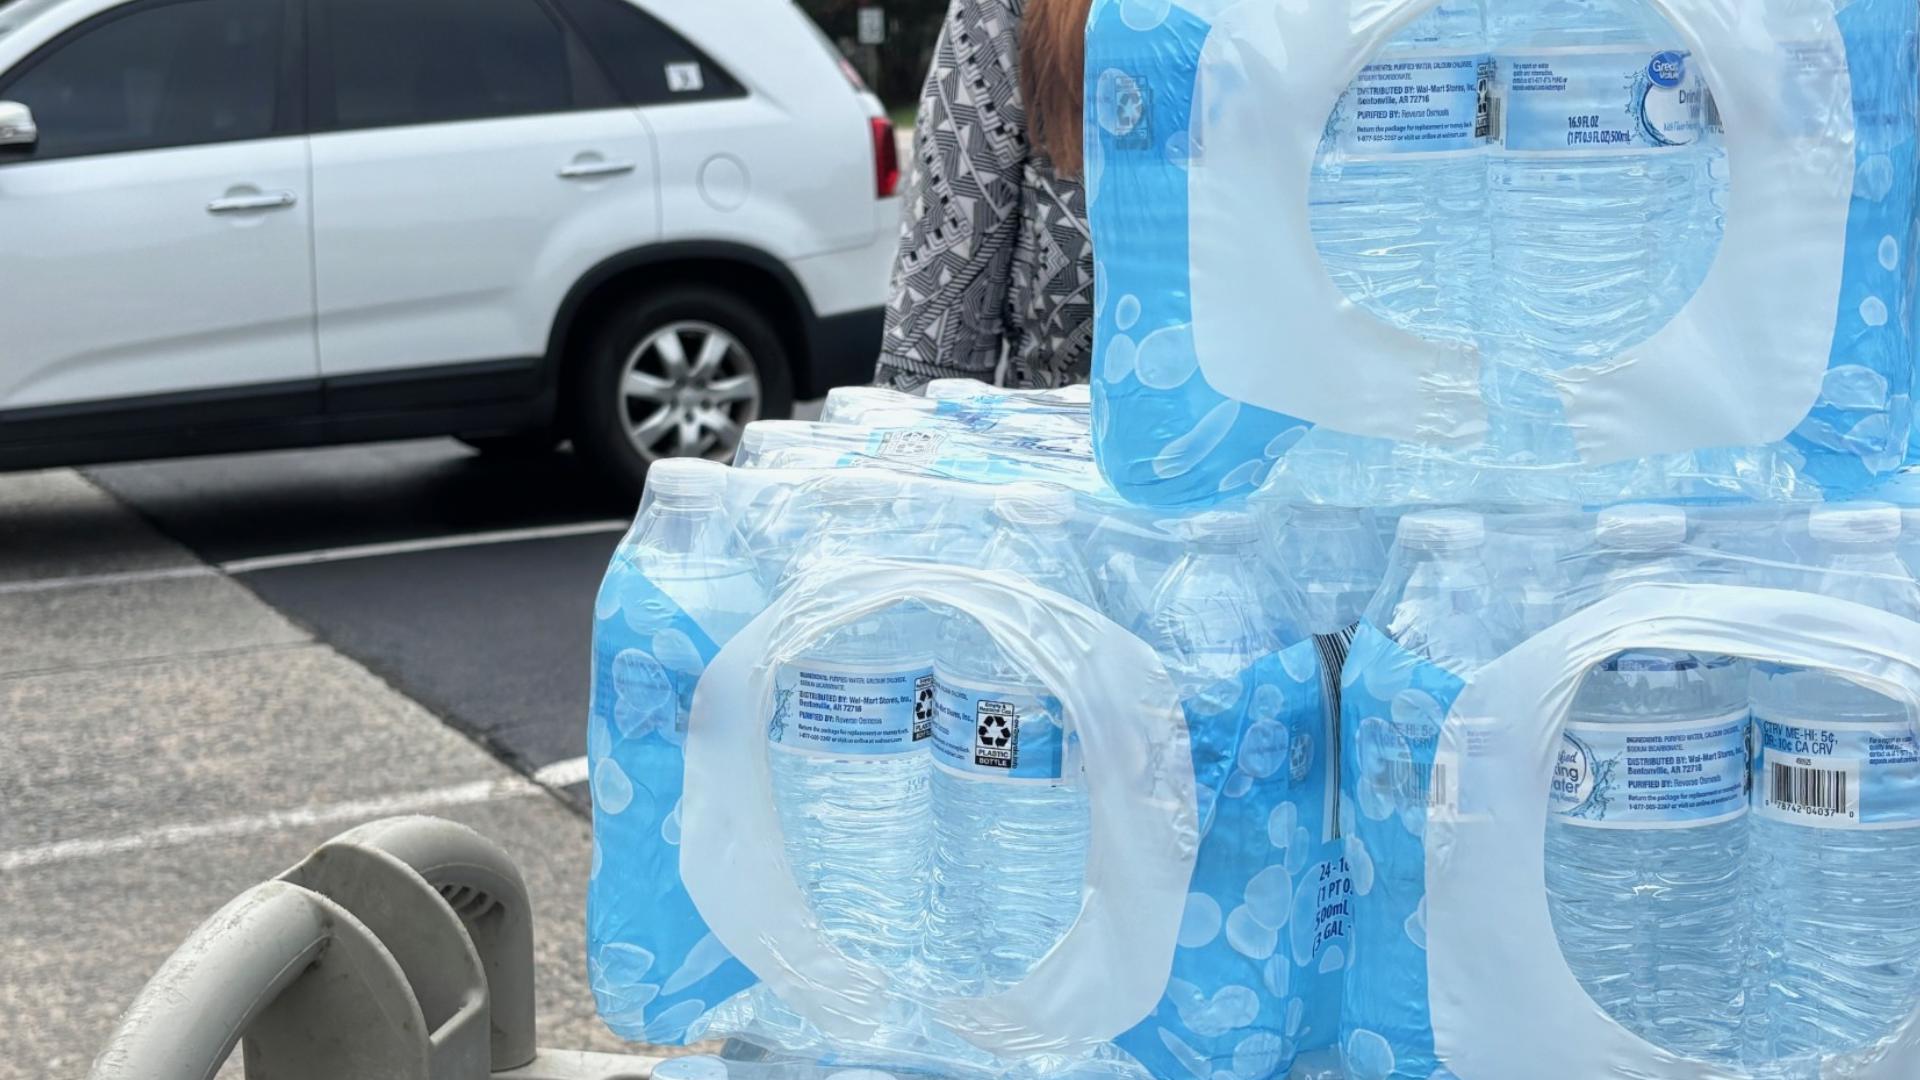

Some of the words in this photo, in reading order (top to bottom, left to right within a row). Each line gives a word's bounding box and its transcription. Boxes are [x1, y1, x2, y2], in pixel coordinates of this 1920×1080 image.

[1357, 86, 1403, 96] DISTRIBUTED
[1404, 85, 1415, 95] BY:
[1416, 84, 1445, 94] Wal-Mart
[1398, 95, 1409, 104] AR
[1357, 110, 1388, 119] PURIFIED
[1389, 110, 1401, 118] BY:
[1401, 109, 1425, 118] Reverse
[1568, 115, 1582, 128] 16.9
[1582, 115, 1590, 128] FL
[1590, 115, 1600, 128] OZ
[1567, 131, 1573, 146] (1
[1574, 131, 1582, 144] PT
[1583, 131, 1592, 143] 0.9
[1593, 130, 1600, 143] FL
[838, 694, 849, 703] BY:
[849, 696, 878, 705] Wal-Mart
[1785, 726, 1818, 742] ME-HI:
[1821, 729, 1838, 745] 5¢,
[978, 749, 1009, 758] PLASTIC
[1795, 740, 1809, 753] CA
[1812, 742, 1833, 755] CRV
[979, 757, 1008, 767] BOTTLE
[1627, 757, 1674, 766] DISTRIBUTED
[1675, 756, 1687, 765] BY:
[1688, 752, 1717, 763] Wal-Mart
[1627, 766, 1669, 775] Bentonville,
[1671, 765, 1681, 774] AR
[1553, 779, 1580, 794] ater
[1628, 779, 1660, 789] PURIFIED
[1661, 779, 1673, 788] BY:
[1674, 778, 1698, 787] Reverse
[1806, 806, 1836, 817] 04037
[1849, 810, 1855, 818] 0
[1328, 879, 1342, 899] PT
[1314, 899, 1349, 932] 500mL
[1323, 920, 1344, 940] GAL
